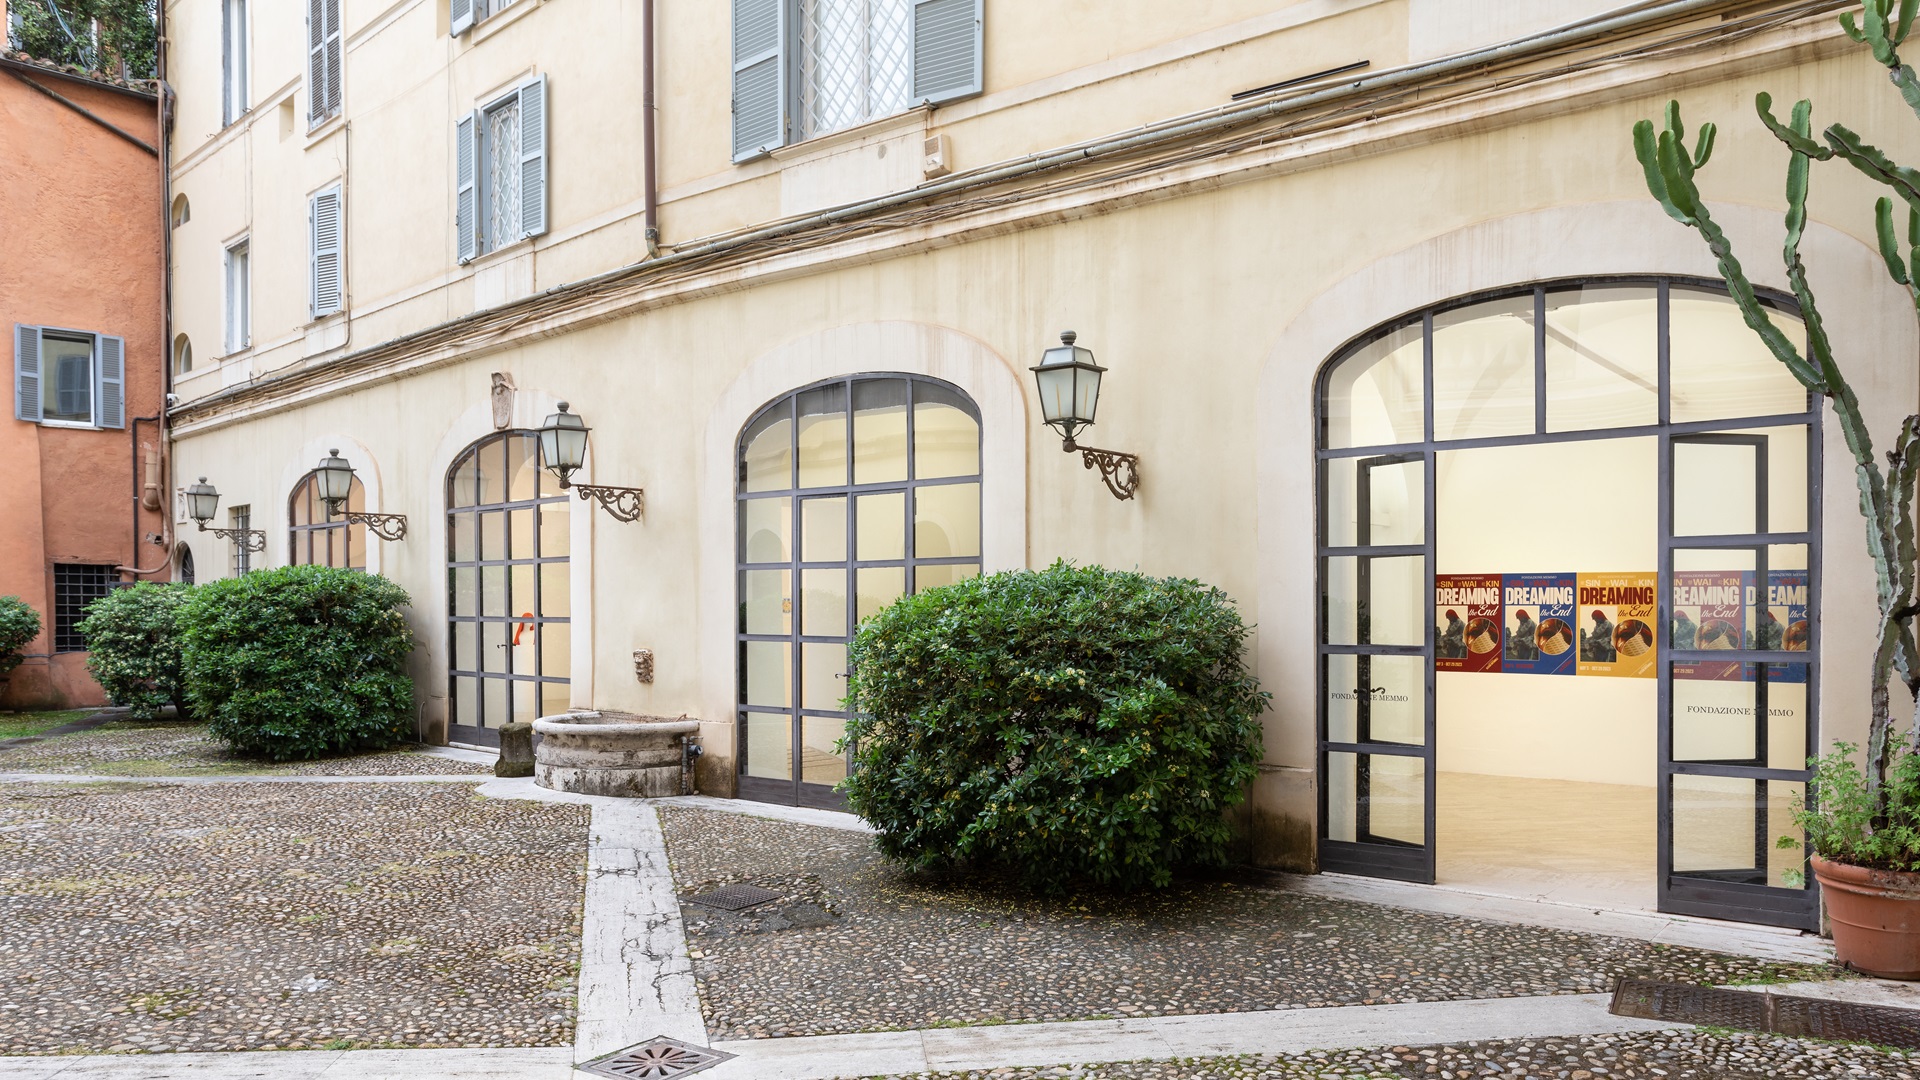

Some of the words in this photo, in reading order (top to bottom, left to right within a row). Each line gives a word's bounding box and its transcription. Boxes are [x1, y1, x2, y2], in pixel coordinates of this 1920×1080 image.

[1693, 578, 1711, 586] WAI
[1436, 588, 1499, 605] DREAMING
[1505, 587, 1573, 605] DREAMING
[1580, 587, 1653, 605] DREAMING
[1674, 586, 1739, 605] REAMING
[1746, 586, 1807, 605] DEAMI
[1468, 608, 1477, 616] the
[1478, 604, 1499, 616] End
[1540, 609, 1550, 617] the
[1550, 604, 1573, 617] End
[1618, 609, 1628, 617] the
[1629, 604, 1653, 617] End
[1701, 610, 1712, 618] the
[1712, 605, 1739, 618] End
[1379, 694, 1408, 702] MEMMO
[1687, 705, 1750, 716] FONDAZIONE
[1753, 707, 1794, 717] MMO
